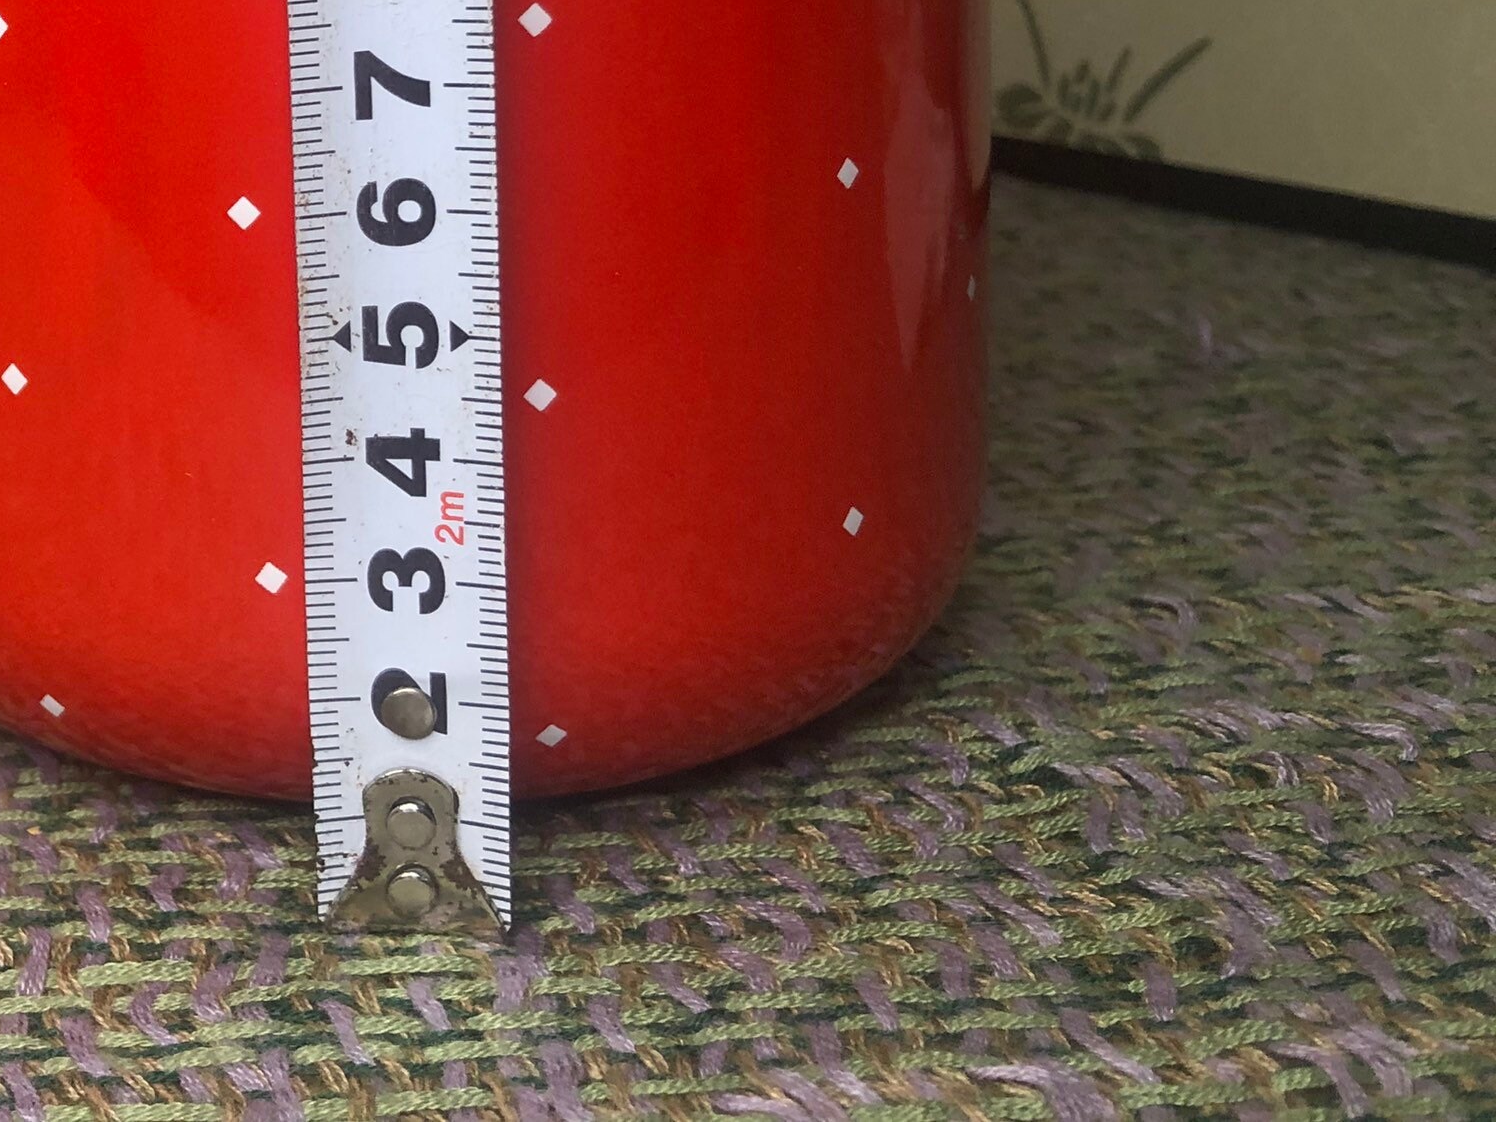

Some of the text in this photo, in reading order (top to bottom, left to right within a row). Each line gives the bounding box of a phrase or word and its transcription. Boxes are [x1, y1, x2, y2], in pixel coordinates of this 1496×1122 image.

[353, 50, 432, 121] 7
[356, 177, 437, 247] 6
[361, 300, 440, 370] 5
[364, 427, 442, 498] 4
[434, 490, 466, 546] 2m
[366, 546, 446, 615] 3
